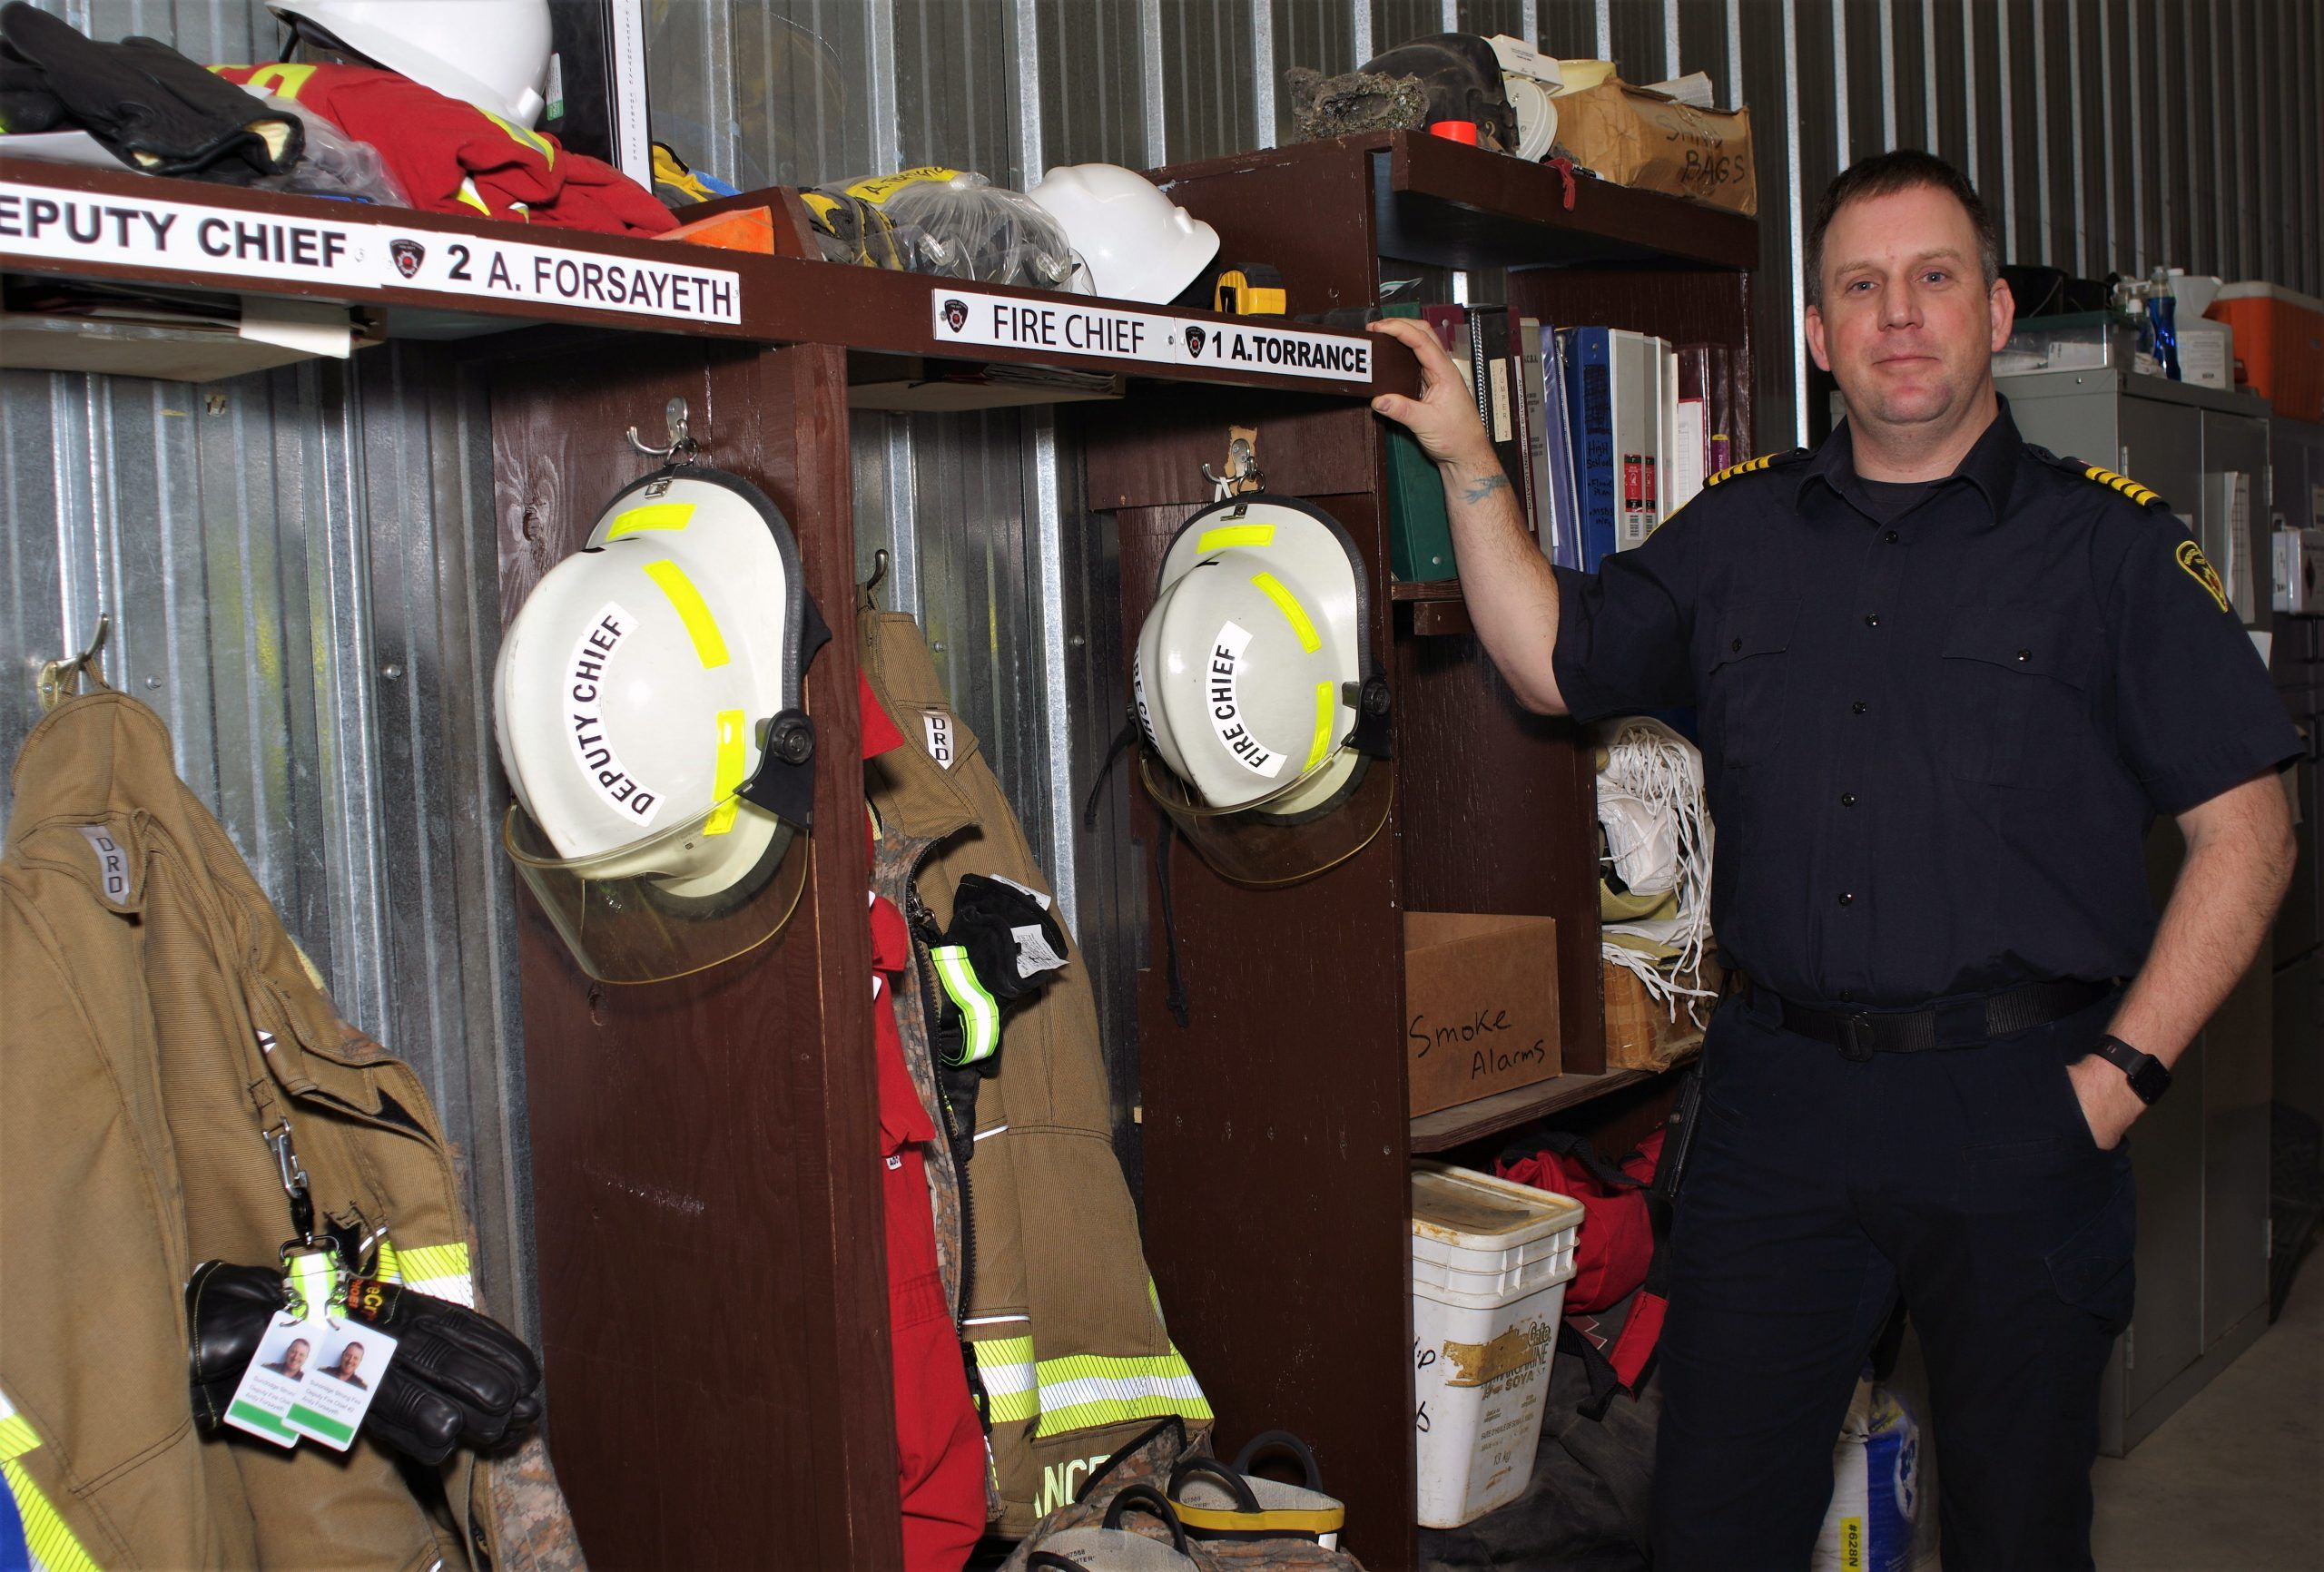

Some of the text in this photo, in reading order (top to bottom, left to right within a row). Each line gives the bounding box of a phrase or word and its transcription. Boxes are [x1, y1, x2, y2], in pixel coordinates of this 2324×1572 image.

[1680, 149, 1745, 184] BAGS
[198, 218, 347, 269] CHIEF
[448, 244, 732, 318] 2 A. FORSAYETH
[993, 304, 1145, 353] FIRE CHIEF
[1212, 330, 1368, 374] 1 A.TORRANCE
[573, 614, 655, 815] DEPUTY CHIEF
[1211, 644, 1270, 768] FIRE CHIEF
[931, 717, 949, 761] DRD
[96, 837, 123, 894] DRD
[1409, 1009, 1512, 1058] Smoke
[1472, 1039, 1545, 1080] Alarms
[1505, 1371, 1534, 1391] SOYA
[1848, 1524, 1858, 1567] #628N
